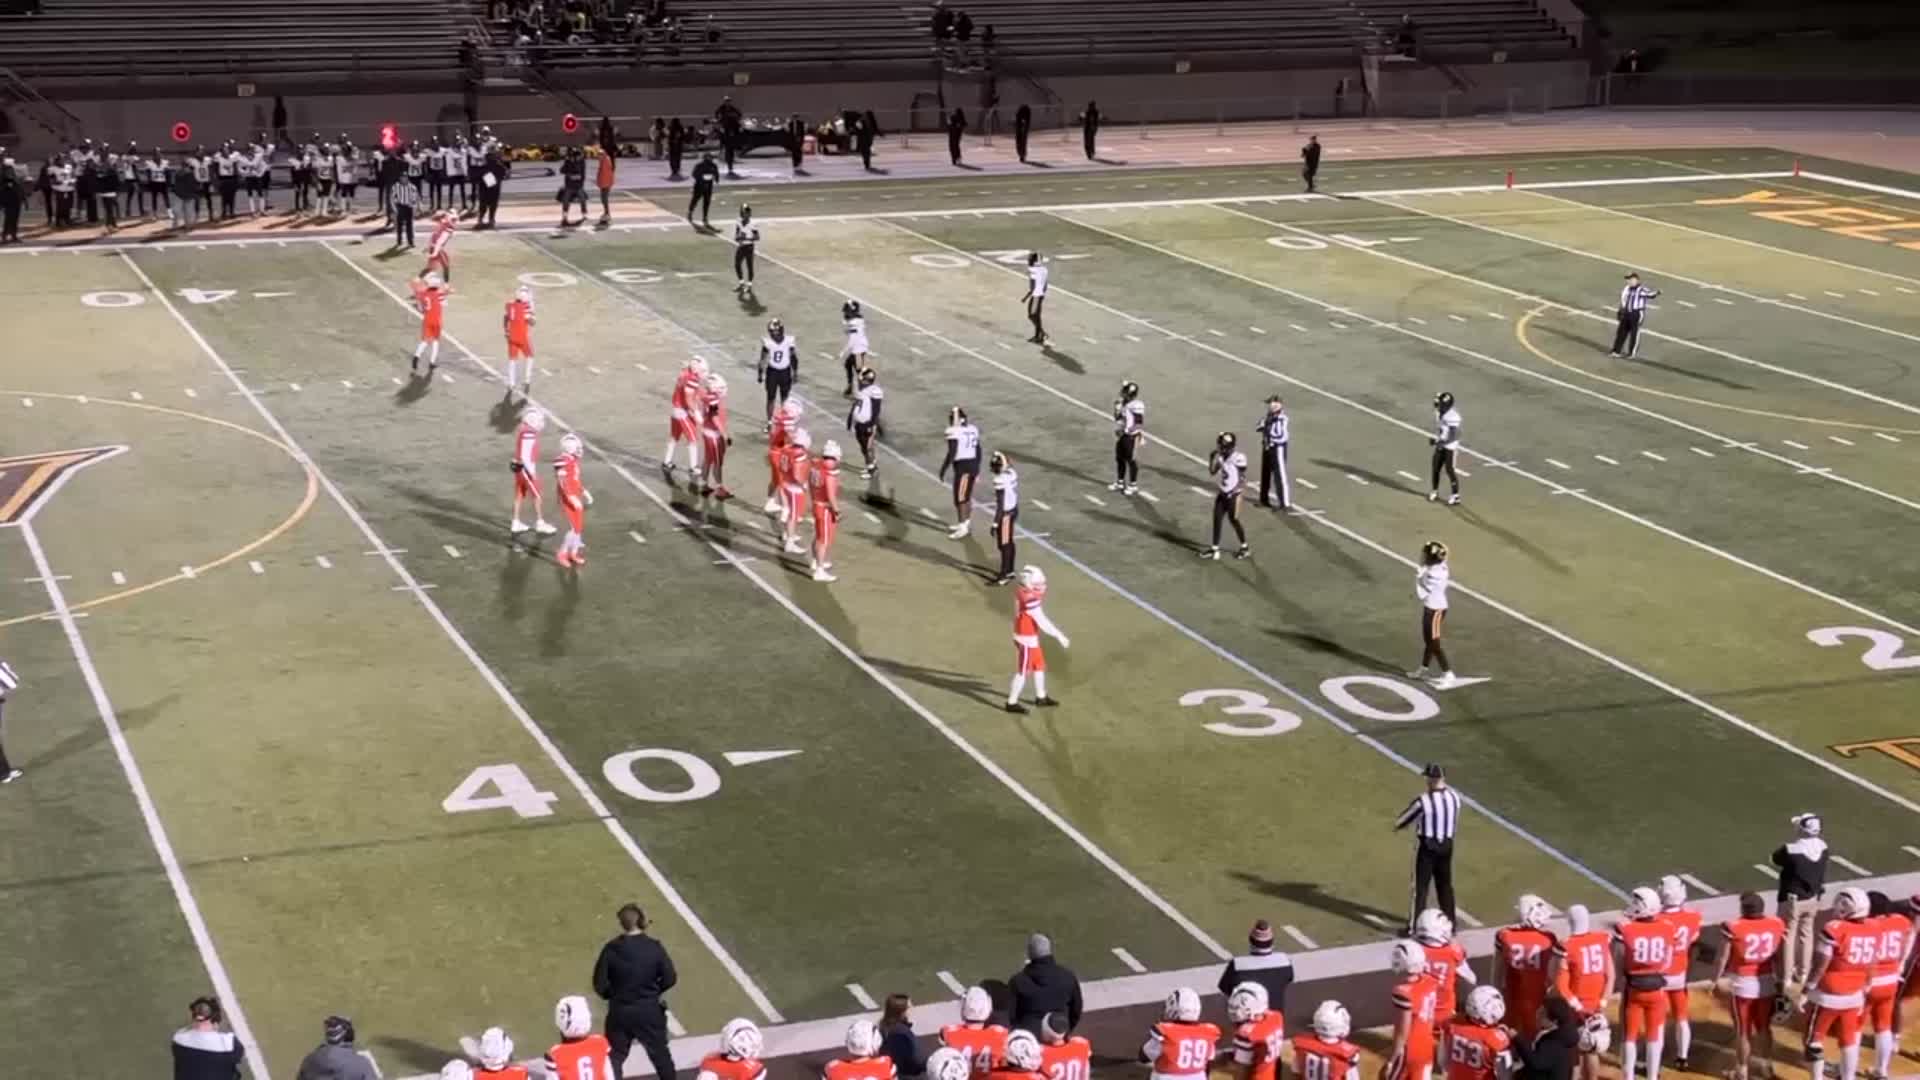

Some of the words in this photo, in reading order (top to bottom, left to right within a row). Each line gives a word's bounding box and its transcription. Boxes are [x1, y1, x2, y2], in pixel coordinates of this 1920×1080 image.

[1178, 675, 1441, 737] 30
[442, 748, 722, 818] 40
[1580, 944, 1604, 974] 15
[1744, 932, 1775, 961] 23
[1177, 1039, 1209, 1069] 69
